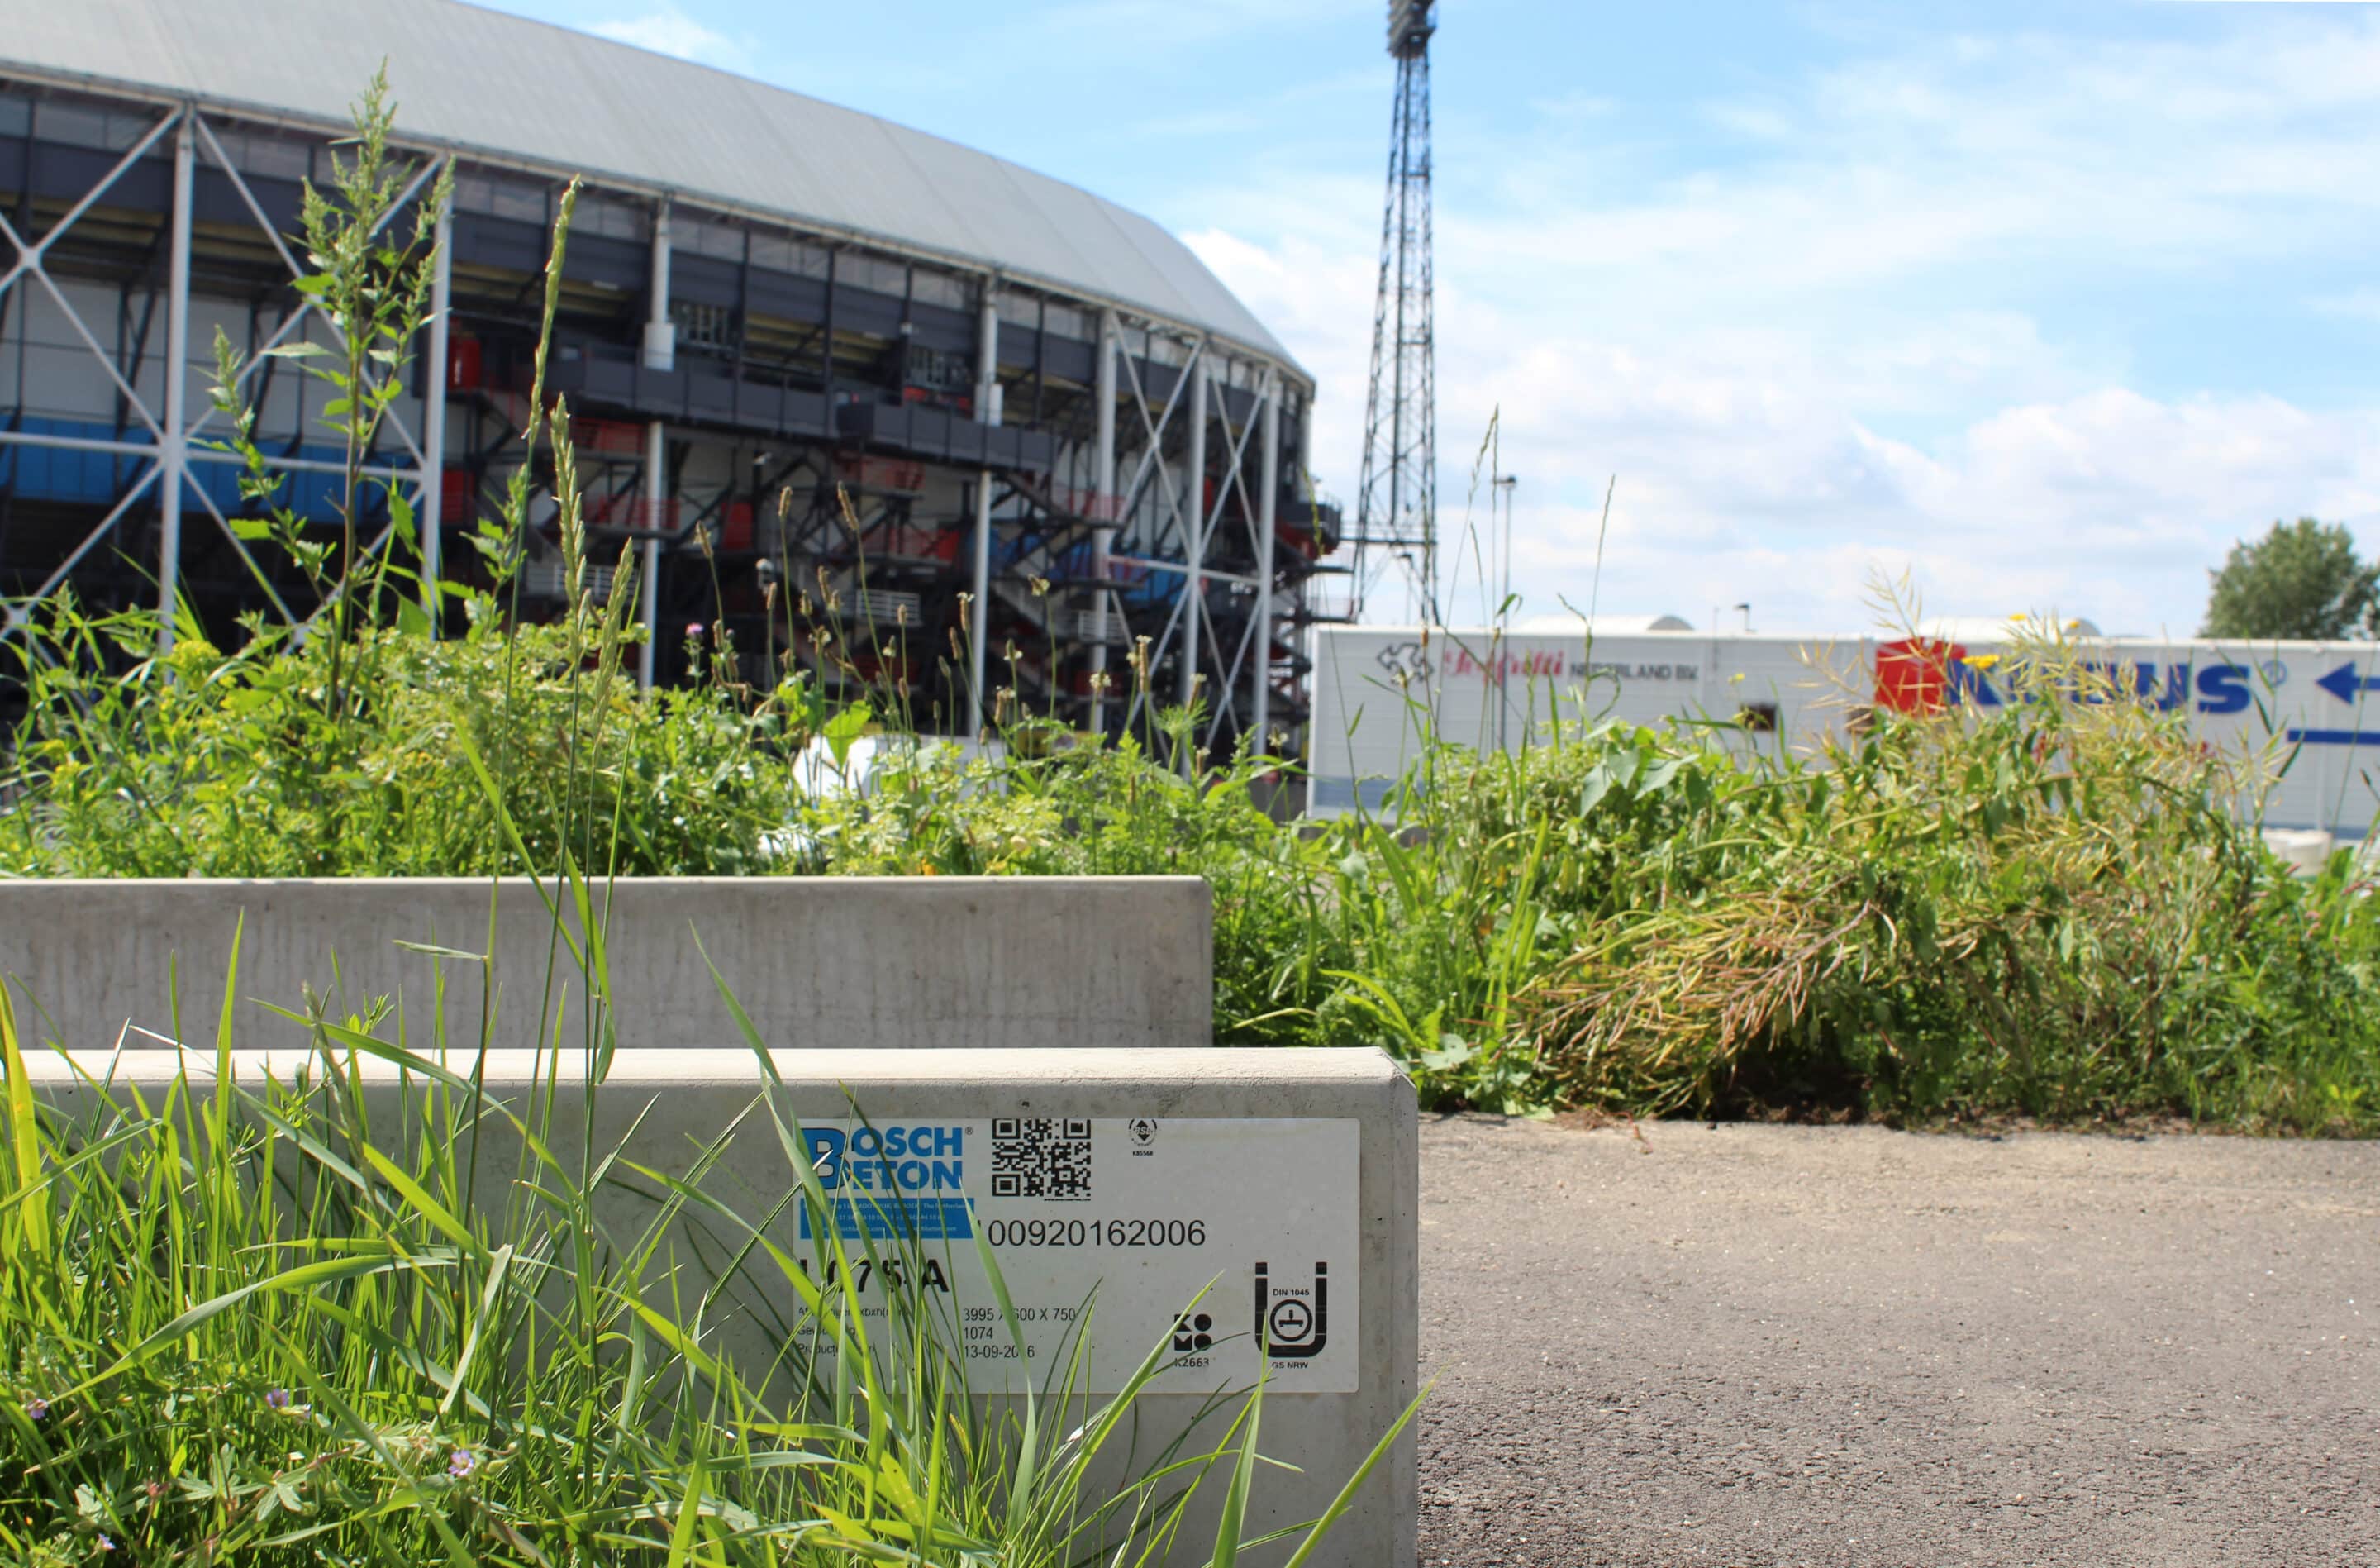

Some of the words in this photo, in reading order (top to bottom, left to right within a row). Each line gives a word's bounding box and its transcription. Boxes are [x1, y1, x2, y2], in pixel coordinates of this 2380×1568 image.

[972, 1219, 1207, 1246] 00920162006
[1054, 1308, 1076, 1321] 750
[964, 1327, 993, 1339] 1074
[964, 1345, 1035, 1358] 13-09-206
